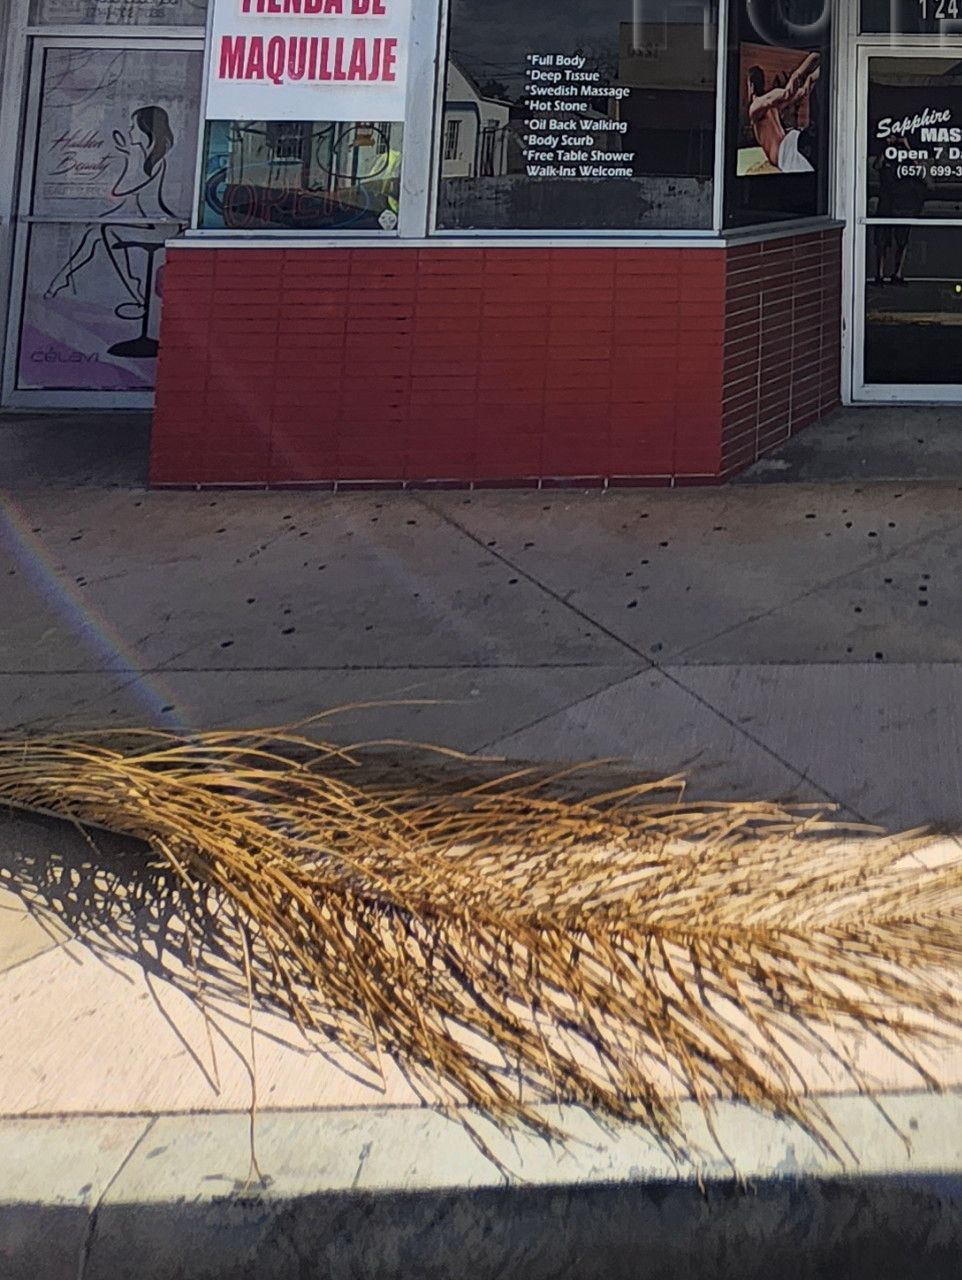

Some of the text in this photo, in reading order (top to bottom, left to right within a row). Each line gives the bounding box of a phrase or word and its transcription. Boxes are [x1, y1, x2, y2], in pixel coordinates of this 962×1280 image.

[219, 35, 398, 84] MAQUILLAJE
[555, 55, 585, 68] Body
[564, 70, 600, 81] Tissue
[580, 85, 630, 99] Massage
[554, 100, 588, 111] Stone
[548, 120, 577, 131] Back
[579, 119, 628, 134] Walking
[876, 107, 951, 138] Sapphire
[561, 135, 594, 146] Scurb
[556, 150, 588, 161] Table
[590, 150, 635, 161] Shower
[885, 147, 928, 162] Open
[934, 147, 943, 160] 7
[526, 165, 633, 177] Walk-Ins Welcome
[897, 165, 926, 179] (657)
